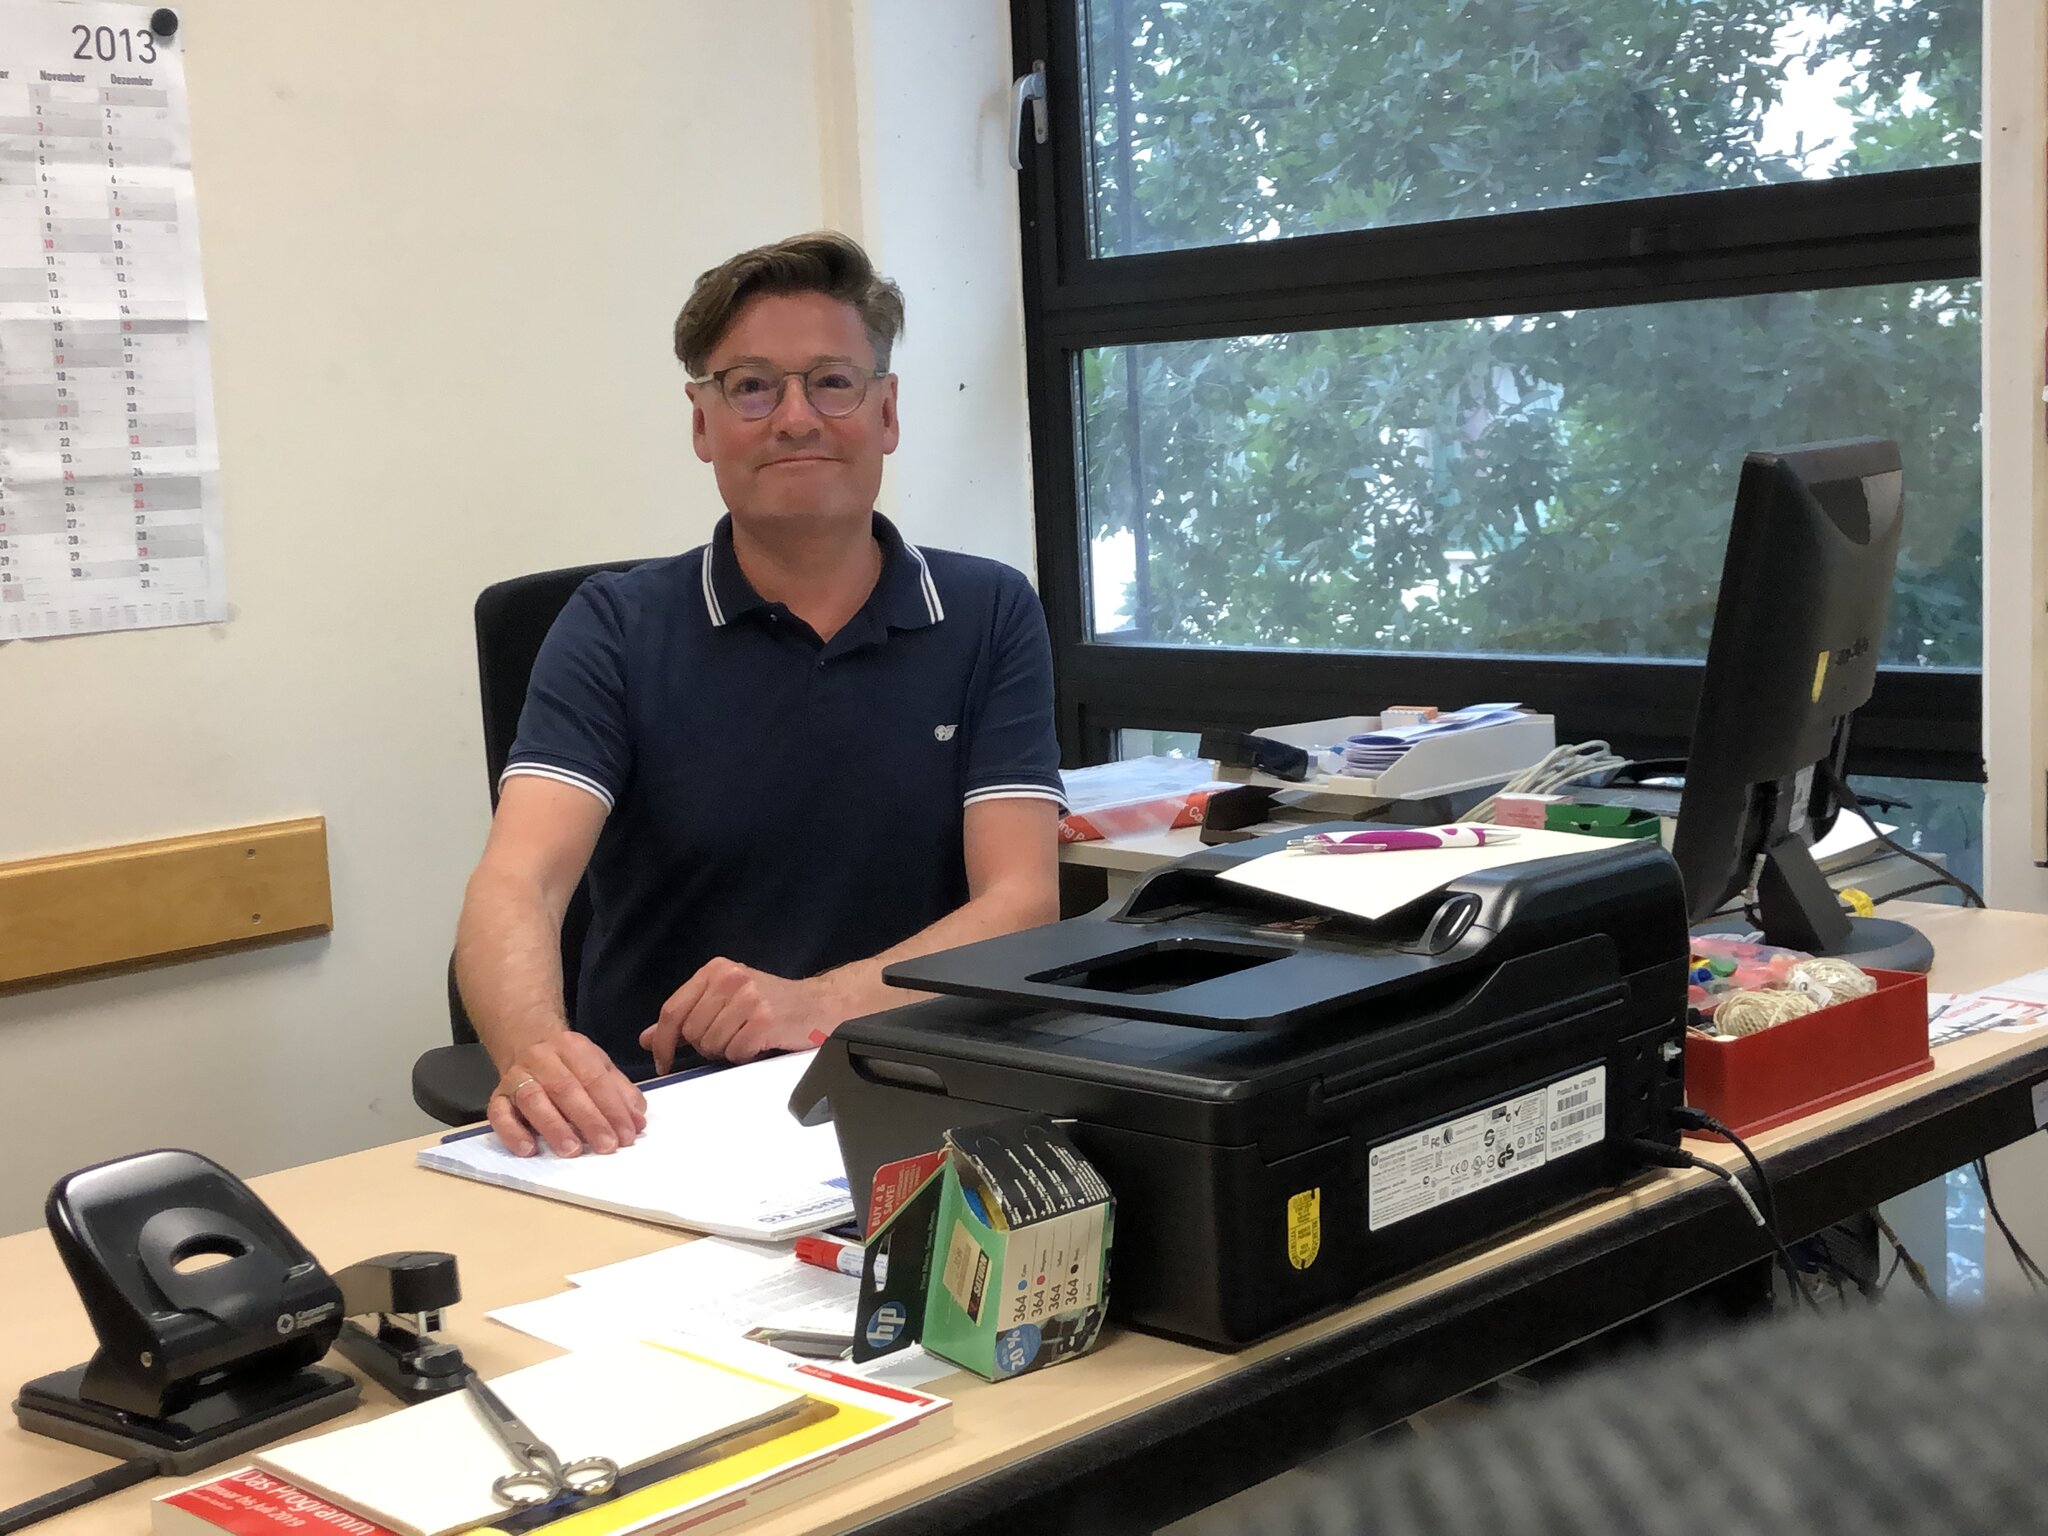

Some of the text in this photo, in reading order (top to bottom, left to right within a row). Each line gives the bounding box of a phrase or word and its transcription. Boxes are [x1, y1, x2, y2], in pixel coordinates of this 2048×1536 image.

[71, 24, 157, 64] 2013
[39, 69, 86, 83] November
[110, 73, 154, 87] Dezember
[105, 92, 109, 101] 1
[36, 105, 42, 115] 2
[106, 108, 111, 118] 2
[37, 122, 43, 132] 3
[107, 125, 113, 135] 3
[39, 139, 45, 149] 4
[108, 142, 114, 151] 4
[39, 155, 45, 165] 5
[108, 158, 114, 168] 5
[42, 173, 47, 182] 6
[111, 175, 116, 184] 6
[43, 189, 48, 198] 7
[113, 190, 118, 199] 7
[45, 205, 51, 215] 8
[116, 223, 122, 233] 9
[46, 256, 55, 265] 11
[115, 256, 124, 265] 11
[48, 272, 57, 282] 12
[116, 272, 126, 282] 12
[49, 289, 59, 299] 13
[119, 289, 128, 298] 13
[51, 305, 61, 315] 14
[120, 305, 130, 314] 14
[53, 321, 63, 331] 15
[54, 338, 64, 348] 16
[123, 337, 132, 347] 16
[124, 353, 133, 363] 17
[56, 371, 66, 381] 18
[57, 388, 67, 397] 19
[126, 386, 135, 396] 19
[59, 421, 68, 431] 21
[128, 419, 138, 429] 21
[60, 438, 70, 447] 22
[129, 435, 139, 445] 22
[62, 454, 72, 464] 23
[131, 451, 141, 461] 23
[133, 467, 143, 477] 24
[64, 486, 75, 496] 25
[66, 503, 76, 513] 26
[67, 519, 77, 529] 27
[136, 515, 145, 525] 27
[68, 535, 79, 545] 28
[70, 552, 80, 561] 29
[141, 579, 150, 589] 31
[882, 1183, 897, 1217] SAVE!
[871, 1183, 886, 1228] BUY 4 &
[972, 1254, 990, 1300] SATURN
[1064, 1278, 1080, 1306] 364
[1047, 1283, 1062, 1312] 364
[1012, 1294, 1028, 1323] 364
[1031, 1289, 1046, 1318] 364
[866, 1305, 907, 1343] hp
[232, 1470, 271, 1492] Das
[271, 1482, 376, 1536] Programm
[236, 1493, 254, 1510] bis
[271, 1508, 306, 1528] 2019
